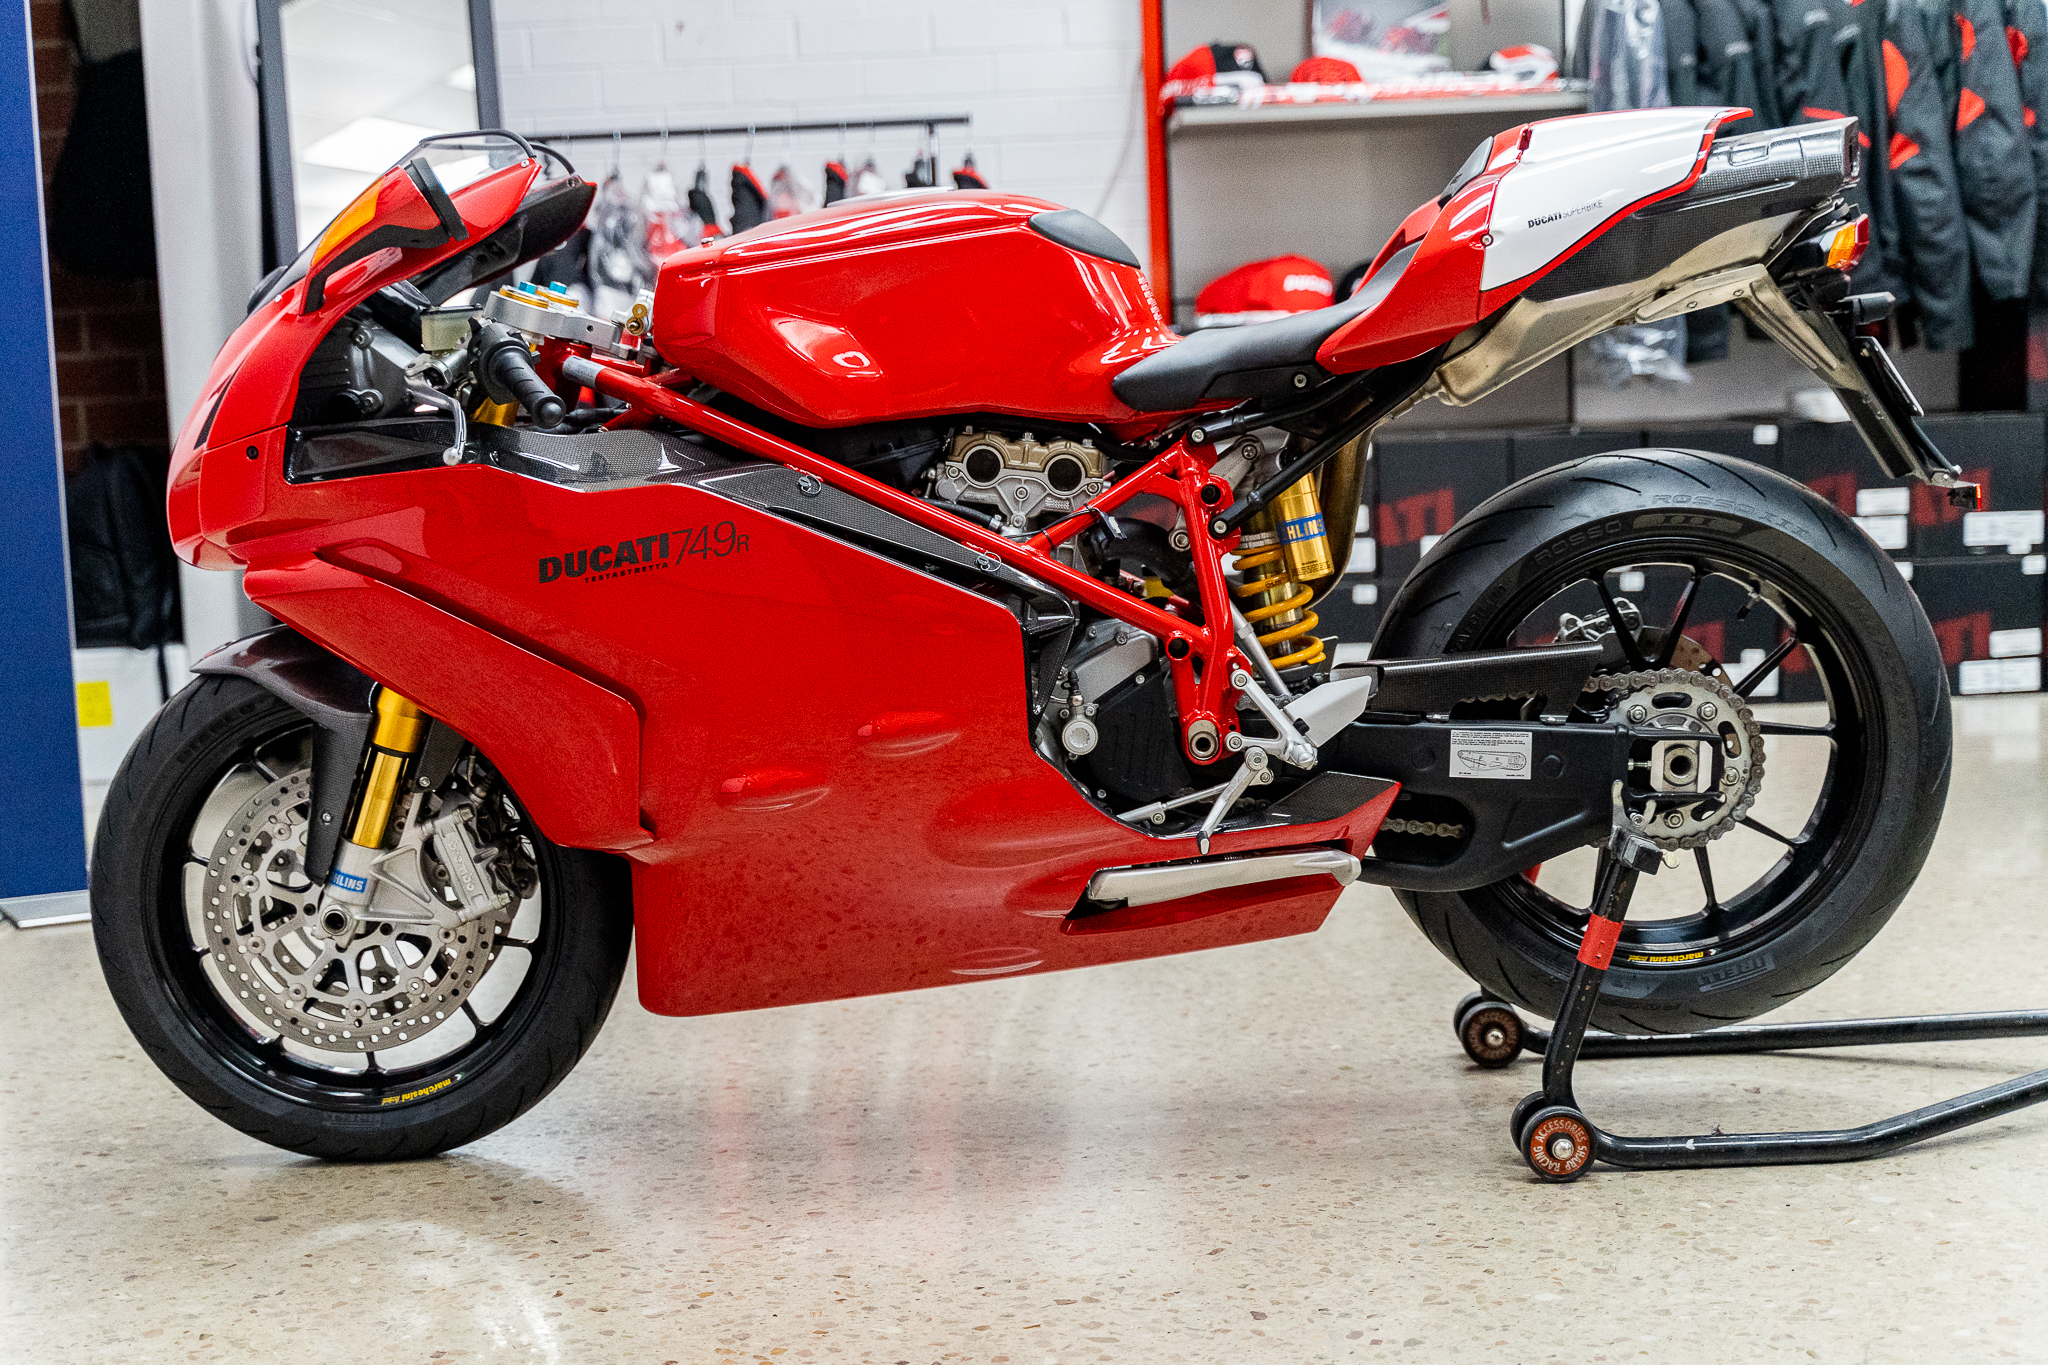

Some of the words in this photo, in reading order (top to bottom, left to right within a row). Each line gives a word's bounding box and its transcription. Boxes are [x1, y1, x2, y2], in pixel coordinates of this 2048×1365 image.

[1527, 211, 1562, 229] DUCATI
[1282, 518, 1324, 541] HLINS
[538, 532, 670, 584] DUCATI
[584, 561, 669, 583] TESTASTRETTA
[449, 839, 476, 892] brembo
[1649, 950, 1704, 962] marchesini
[401, 1078, 452, 1102] marchesini
[1535, 1119, 1587, 1143] ACCESSORIES
[1533, 1145, 1561, 1172] RACING
[1564, 1145, 1587, 1171] SHARP
